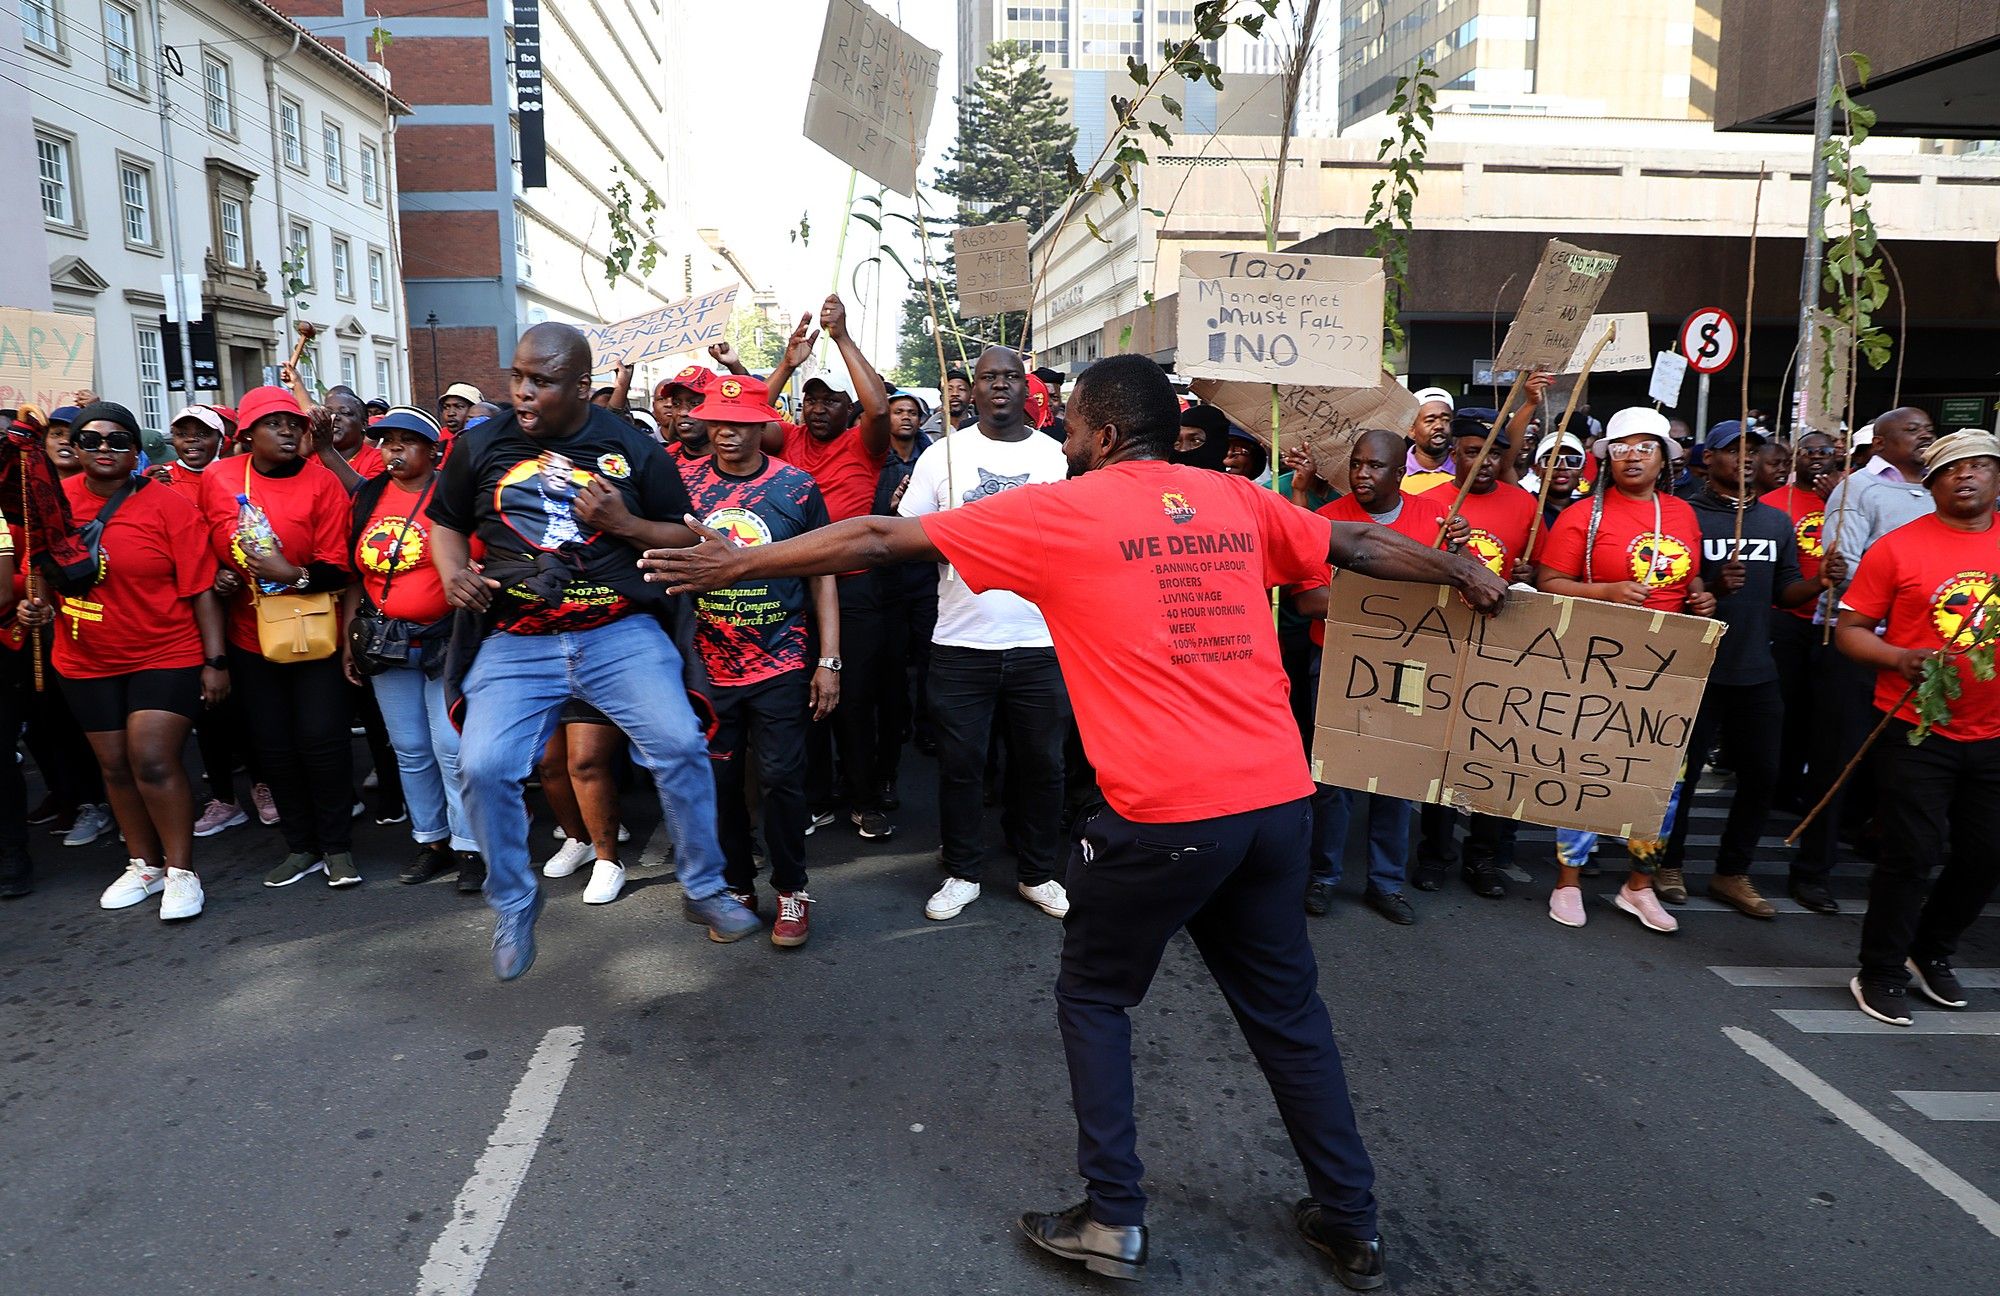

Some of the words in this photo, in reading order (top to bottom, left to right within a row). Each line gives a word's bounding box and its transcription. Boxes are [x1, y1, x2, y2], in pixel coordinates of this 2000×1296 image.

[639, 322, 723, 358] LEAVE
[1697, 323, 1720, 358] S
[1164, 507, 1197, 516] SAFTU
[1119, 537, 1163, 561] WE
[1167, 533, 1255, 556] DEMAND
[1703, 538, 1777, 562] UZZI
[1155, 562, 1199, 575] BANNING
[1200, 561, 1212, 572] OF
[1214, 560, 1246, 571] LABOUR
[1159, 577, 1202, 589] BROKERS
[1162, 592, 1195, 604] LIVING
[1195, 591, 1222, 602] WAGE
[736, 599, 782, 613] Congress
[1166, 608, 1179, 619] 40
[1180, 606, 1206, 618] HOUR
[1207, 605, 1245, 616] WORKING
[1169, 623, 1197, 634] WEEK
[1173, 638, 1197, 650] 100%
[1198, 635, 1235, 648] PAYMENT
[1236, 634, 1252, 645] FOR
[1351, 593, 1678, 692] SALARY
[1170, 653, 1200, 665] SHORT
[1345, 654, 1693, 749] DISCREPANCY
[1469, 727, 1652, 783] MUST
[1454, 761, 1612, 812] STOP
